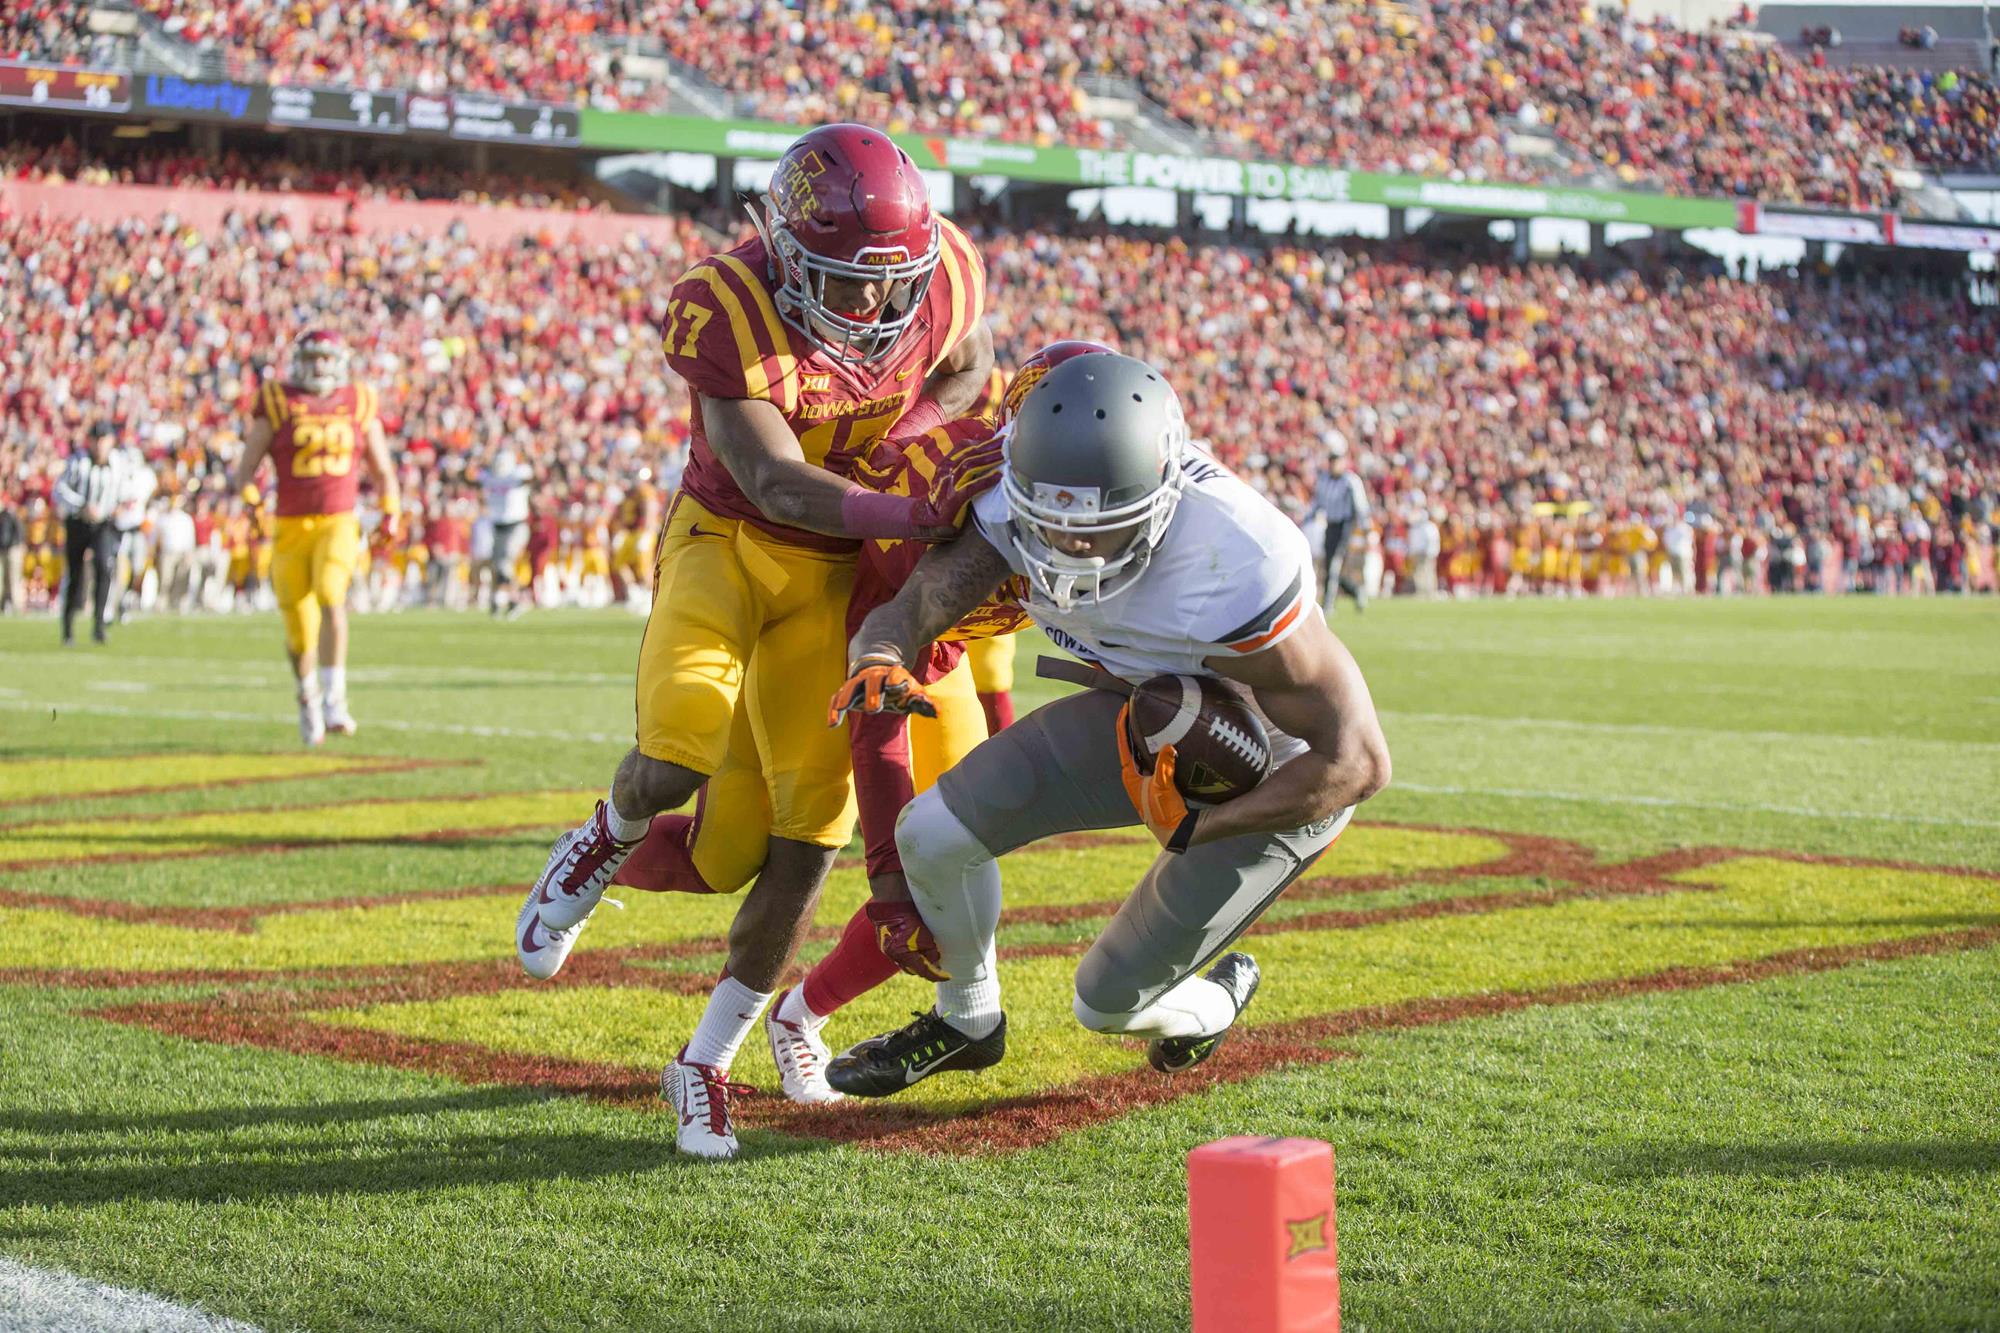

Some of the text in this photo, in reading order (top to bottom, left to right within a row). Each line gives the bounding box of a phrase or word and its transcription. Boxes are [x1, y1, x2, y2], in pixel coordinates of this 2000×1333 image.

[146, 75, 250, 117] Liberty
[1077, 150, 1129, 185] THE
[1133, 153, 1243, 194] POWER
[1246, 162, 1286, 198] TO
[1288, 166, 1351, 201] SAVE
[867, 254, 902, 265] ALL IN
[663, 299, 713, 358] 17
[800, 373, 832, 393] XII
[800, 399, 854, 419] IOWA
[291, 420, 354, 477] 29
